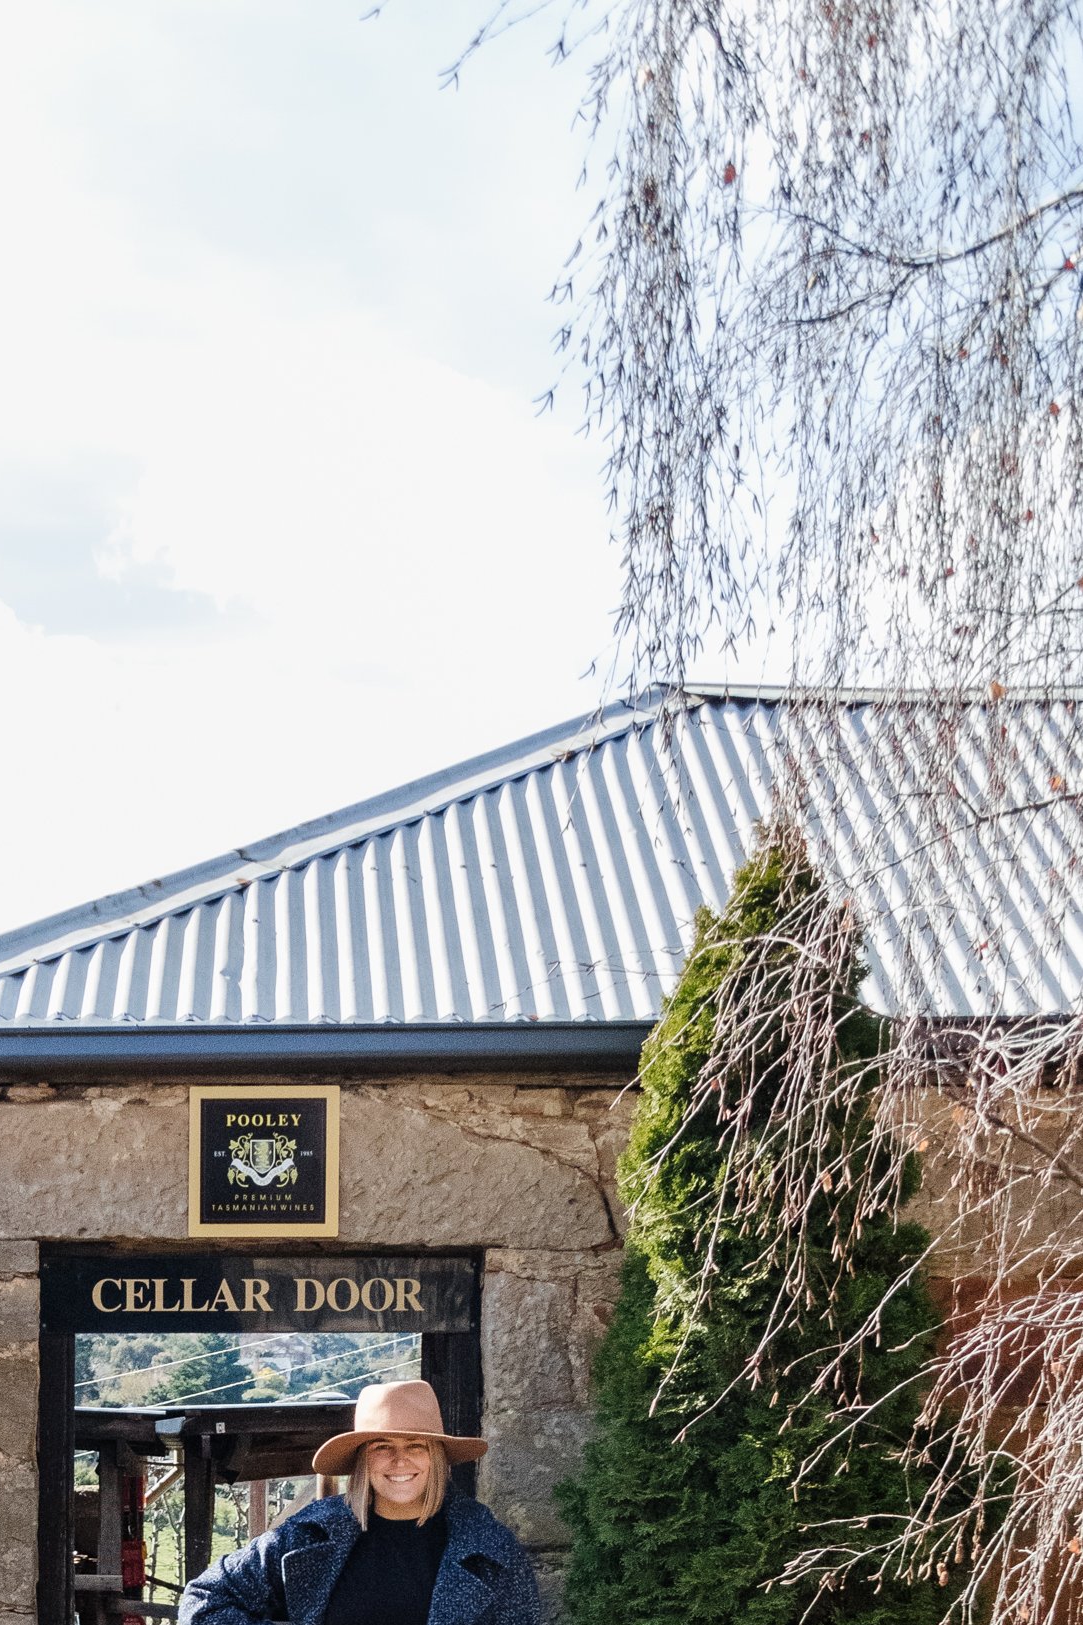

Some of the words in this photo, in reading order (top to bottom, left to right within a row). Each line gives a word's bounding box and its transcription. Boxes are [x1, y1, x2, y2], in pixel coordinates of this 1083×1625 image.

[226, 1114, 302, 1127] POOLEY
[91, 1277, 274, 1313] CELLAR
[293, 1277, 425, 1313] DOOR
